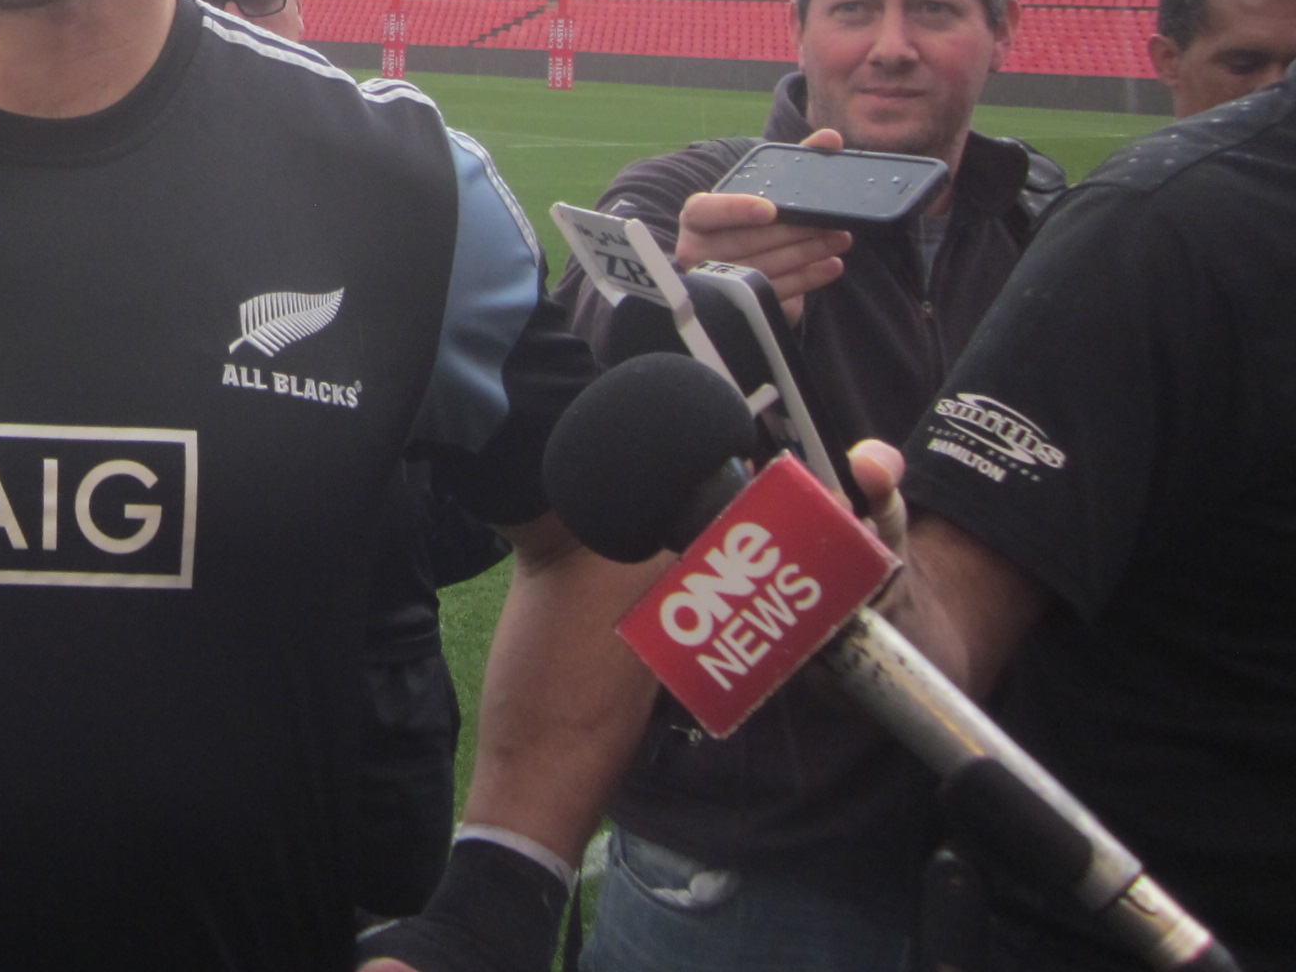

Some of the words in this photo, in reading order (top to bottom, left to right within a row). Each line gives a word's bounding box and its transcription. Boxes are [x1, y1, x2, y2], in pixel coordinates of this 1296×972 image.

[222, 363, 267, 391] ALL
[272, 371, 360, 409] BLACKS
[927, 437, 1007, 483] HAMILTON
[694, 562, 822, 692] NEWS
